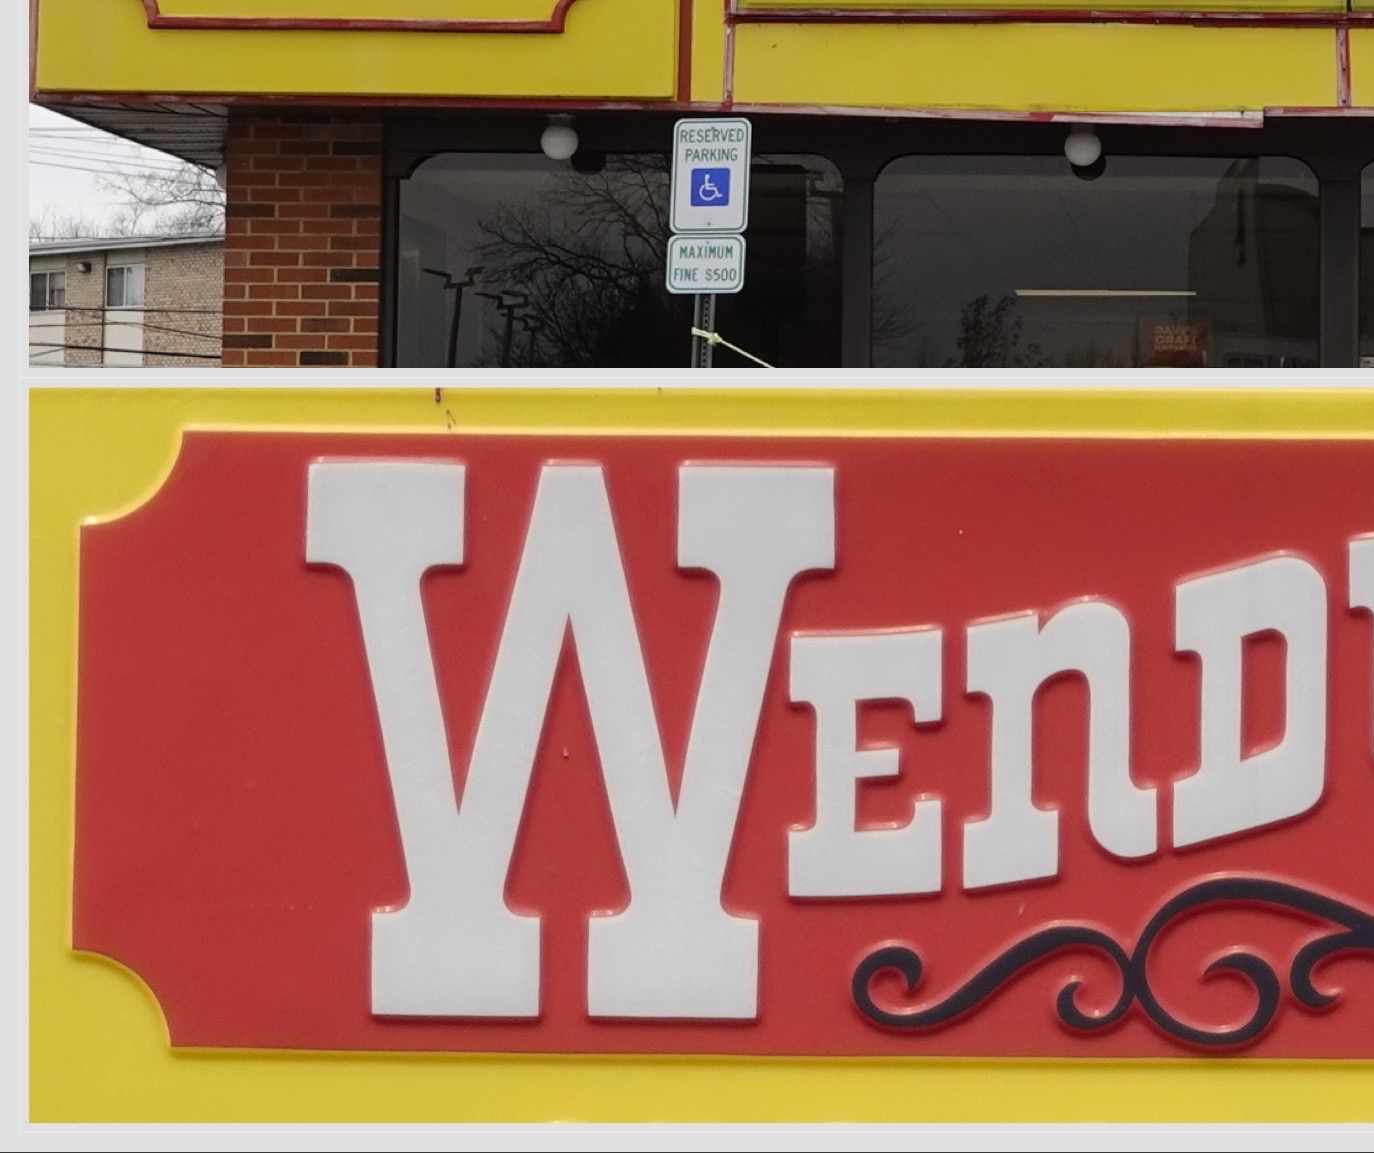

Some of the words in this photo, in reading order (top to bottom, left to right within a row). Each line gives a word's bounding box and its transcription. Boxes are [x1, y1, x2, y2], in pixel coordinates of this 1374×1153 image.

[680, 127, 745, 143] RESERVED
[685, 148, 738, 162] PARKING
[679, 245, 734, 260] MAXIMUM
[673, 268, 698, 282] FINE
[705, 267, 737, 282] $500
